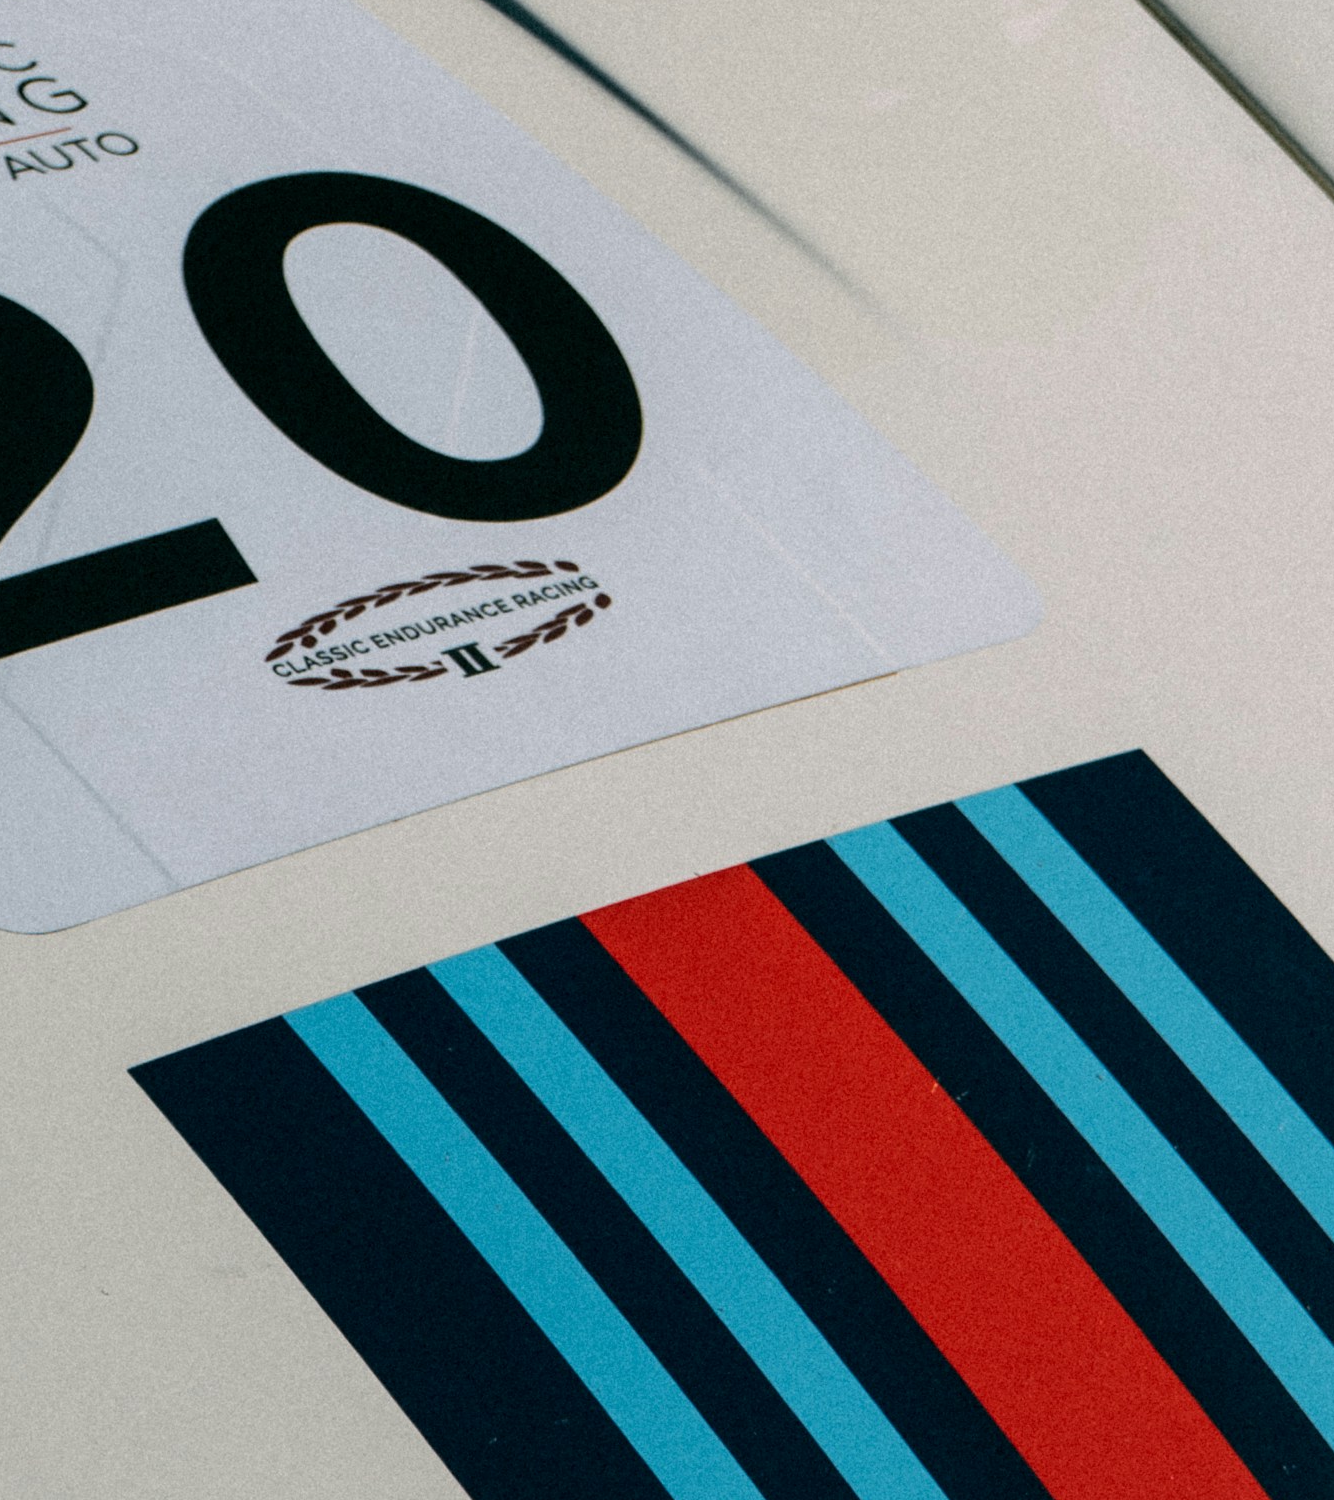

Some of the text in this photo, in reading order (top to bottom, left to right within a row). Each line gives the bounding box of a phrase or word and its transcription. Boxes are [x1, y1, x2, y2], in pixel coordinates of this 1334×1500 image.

[4, 131, 140, 181] AUTO
[272, 575, 600, 679] CLASSIC ENDURANCE RACING
